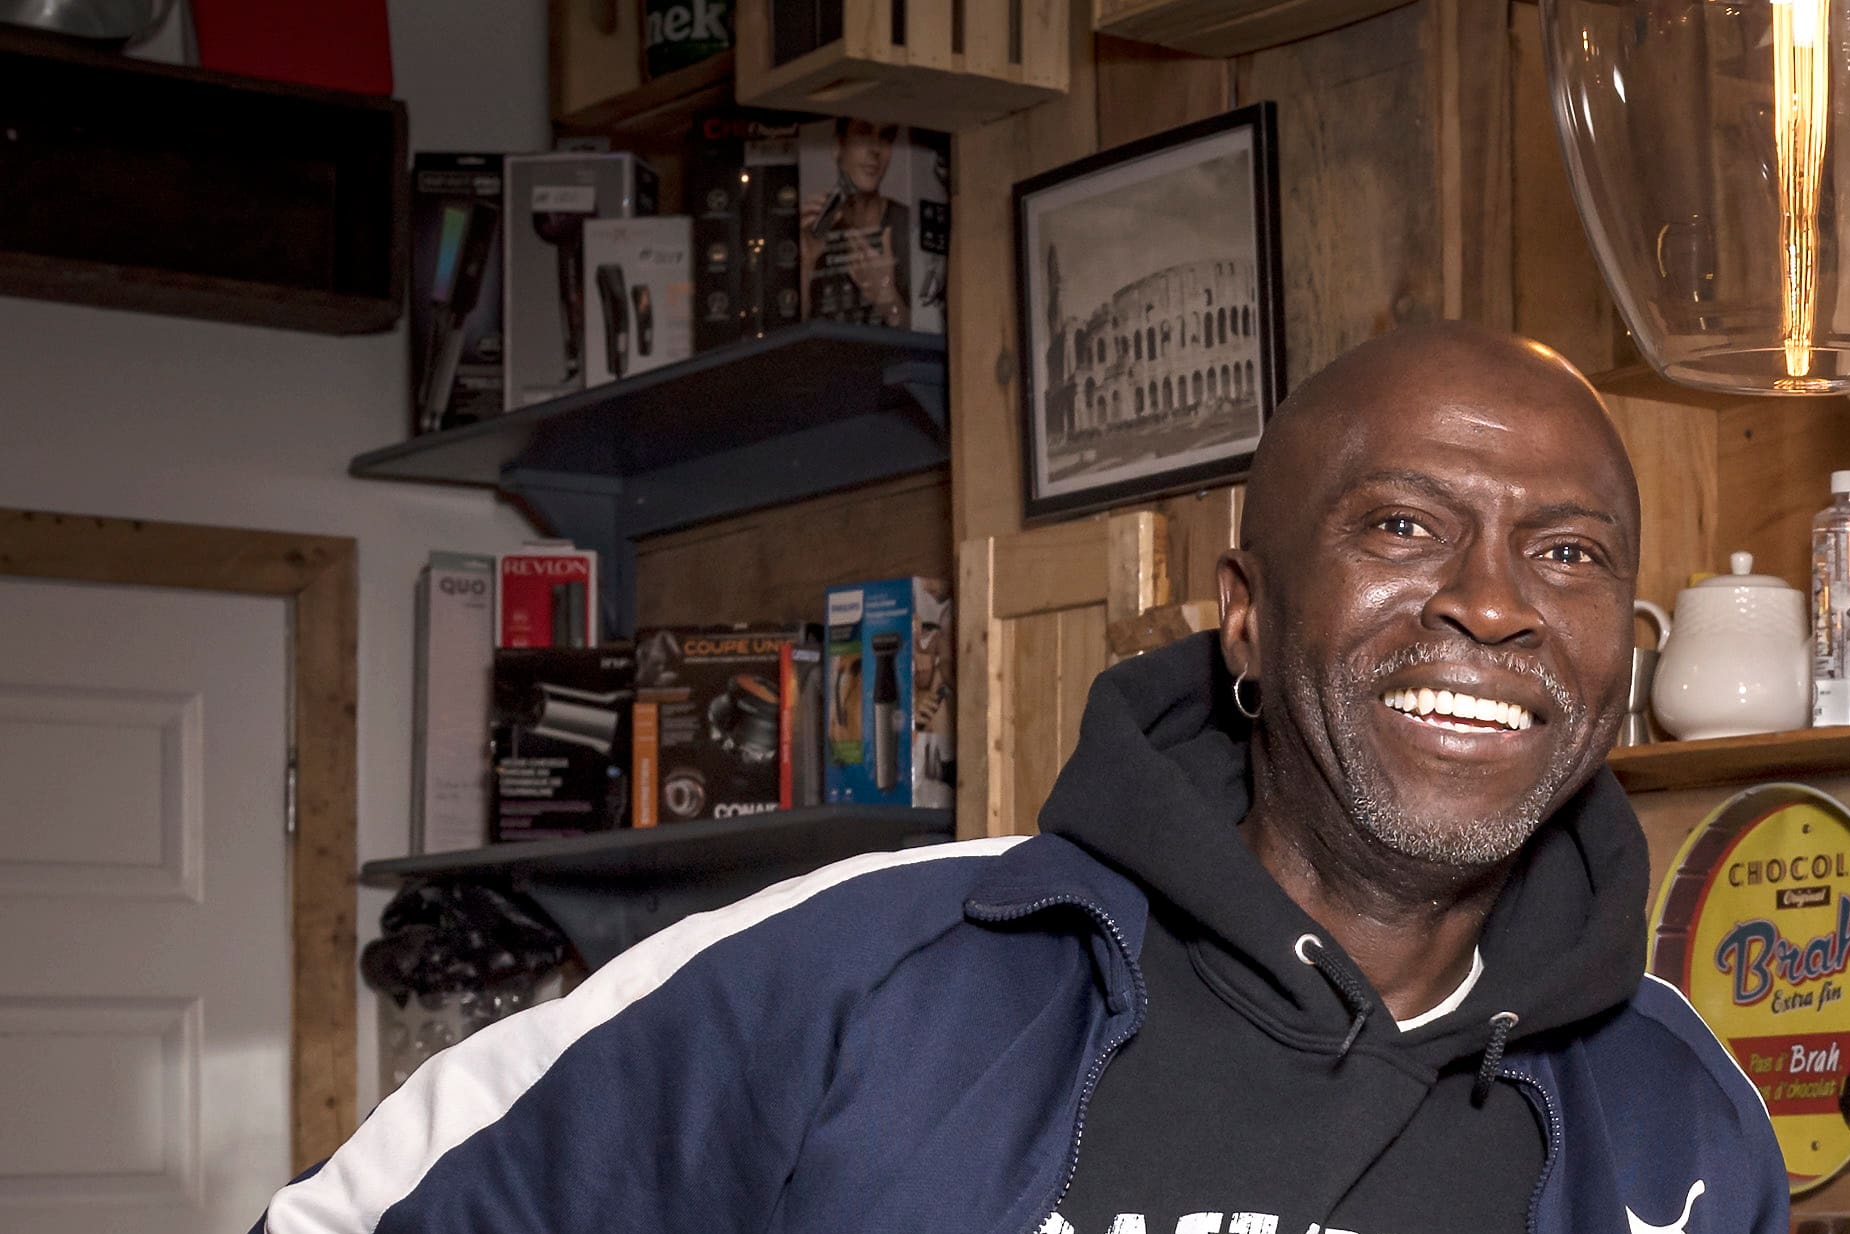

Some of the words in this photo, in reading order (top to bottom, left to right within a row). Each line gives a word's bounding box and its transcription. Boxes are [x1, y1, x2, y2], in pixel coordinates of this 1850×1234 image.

[503, 558, 589, 576] REVLON
[440, 576, 486, 596] QUO
[683, 638, 749, 656] COUPE
[1771, 988, 1813, 1015] Extra
[1816, 980, 1842, 1012] fin
